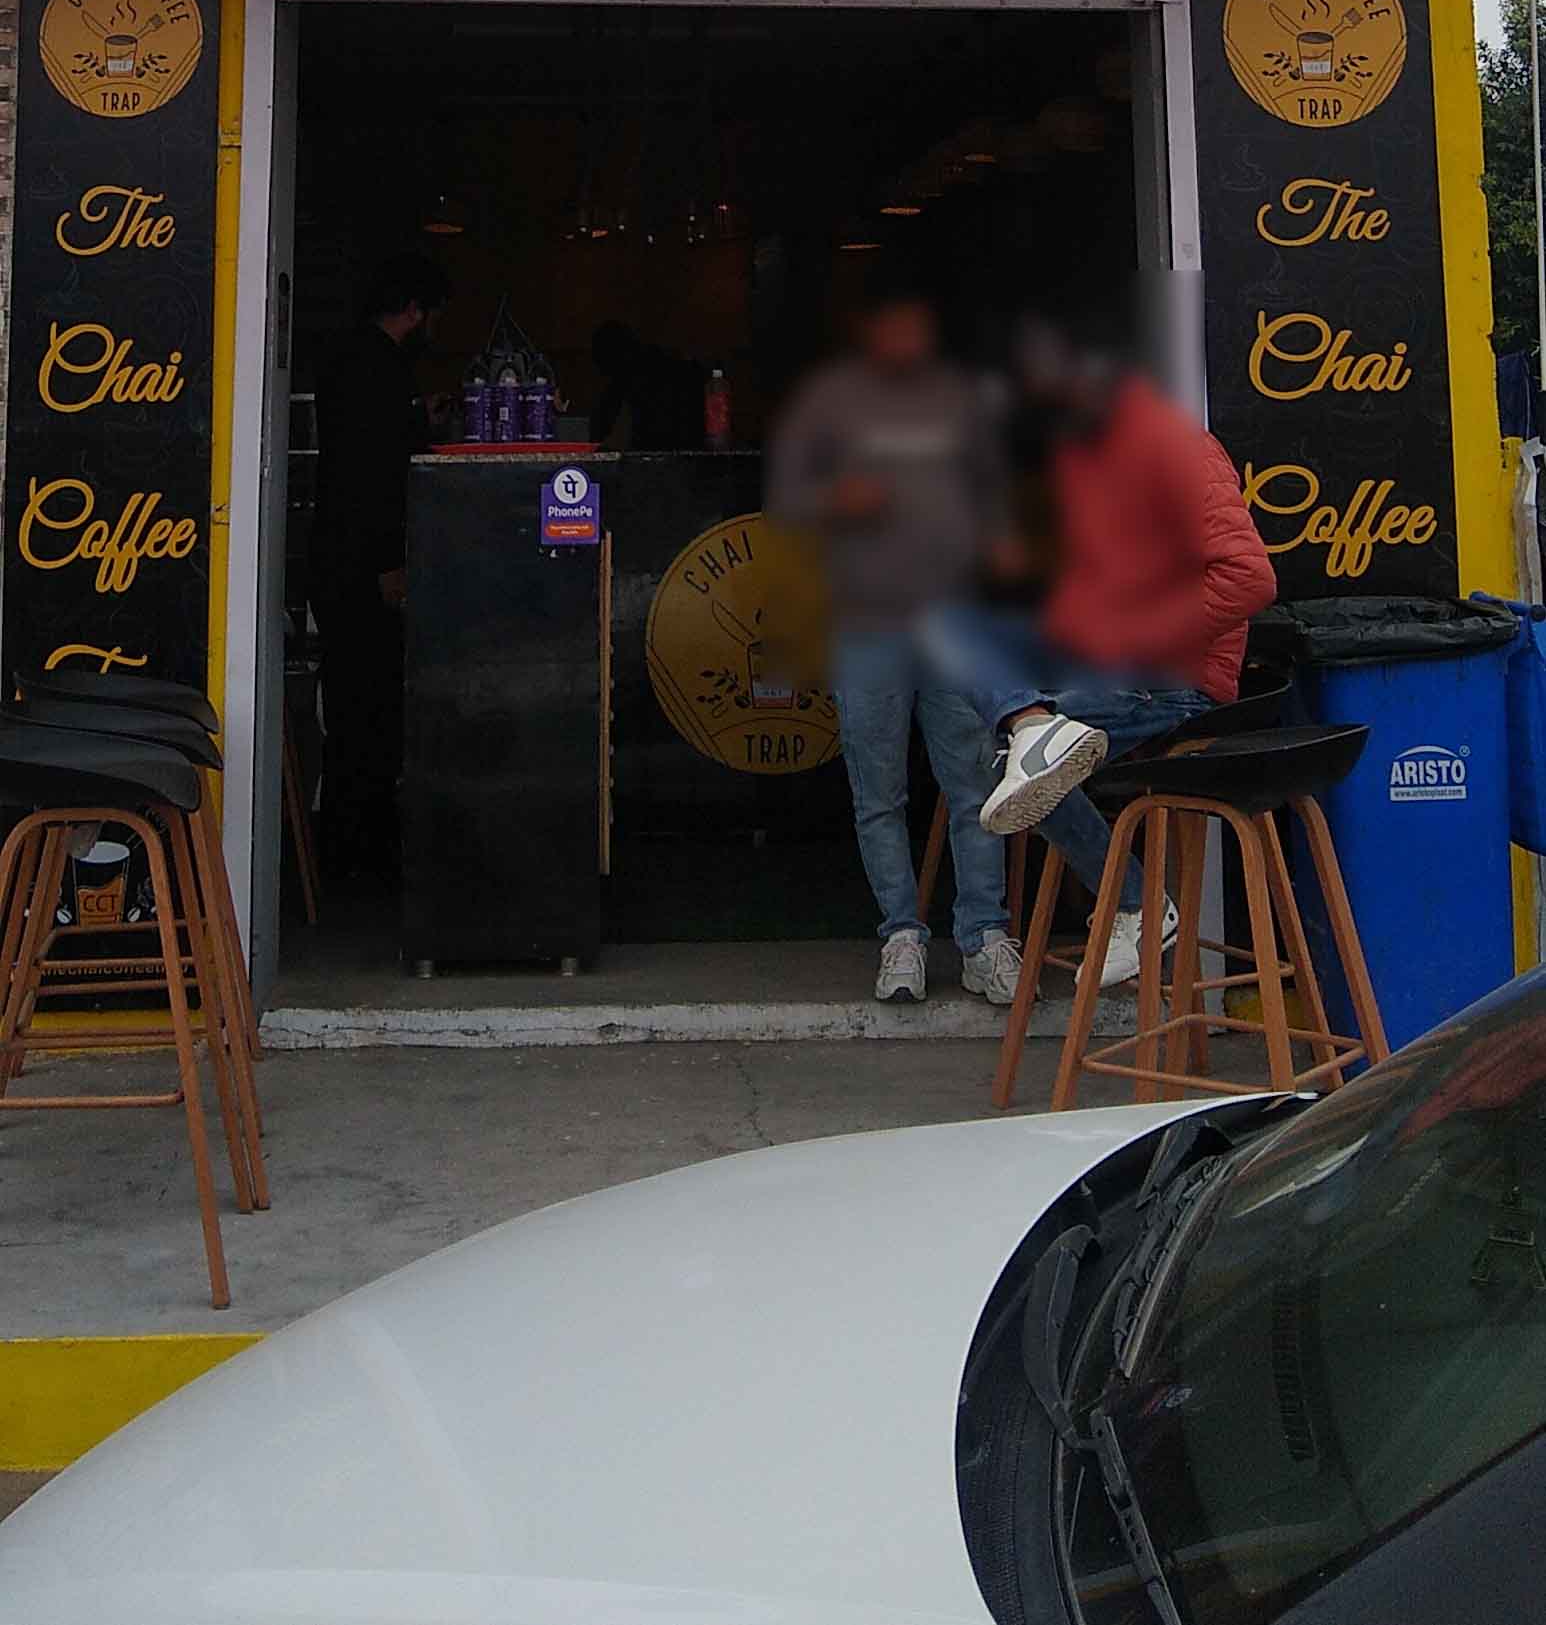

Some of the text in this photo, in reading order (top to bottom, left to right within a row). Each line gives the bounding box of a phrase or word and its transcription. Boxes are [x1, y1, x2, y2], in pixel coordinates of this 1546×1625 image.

[101, 91, 141, 112] TRAP
[1297, 97, 1343, 120] TRAP
[55, 184, 176, 257] The
[1255, 178, 1392, 247] The
[38, 320, 186, 414] Chai
[1248, 309, 1413, 401] Chai
[18, 477, 198, 594] Coffee
[547, 504, 594, 518] PhonePe
[1242, 461, 1438, 579] Coffee
[683, 530, 754, 594] CHAI
[743, 733, 806, 765] TRAP
[1390, 759, 1466, 785] ARISTO
[82, 894, 118, 914] CCT
